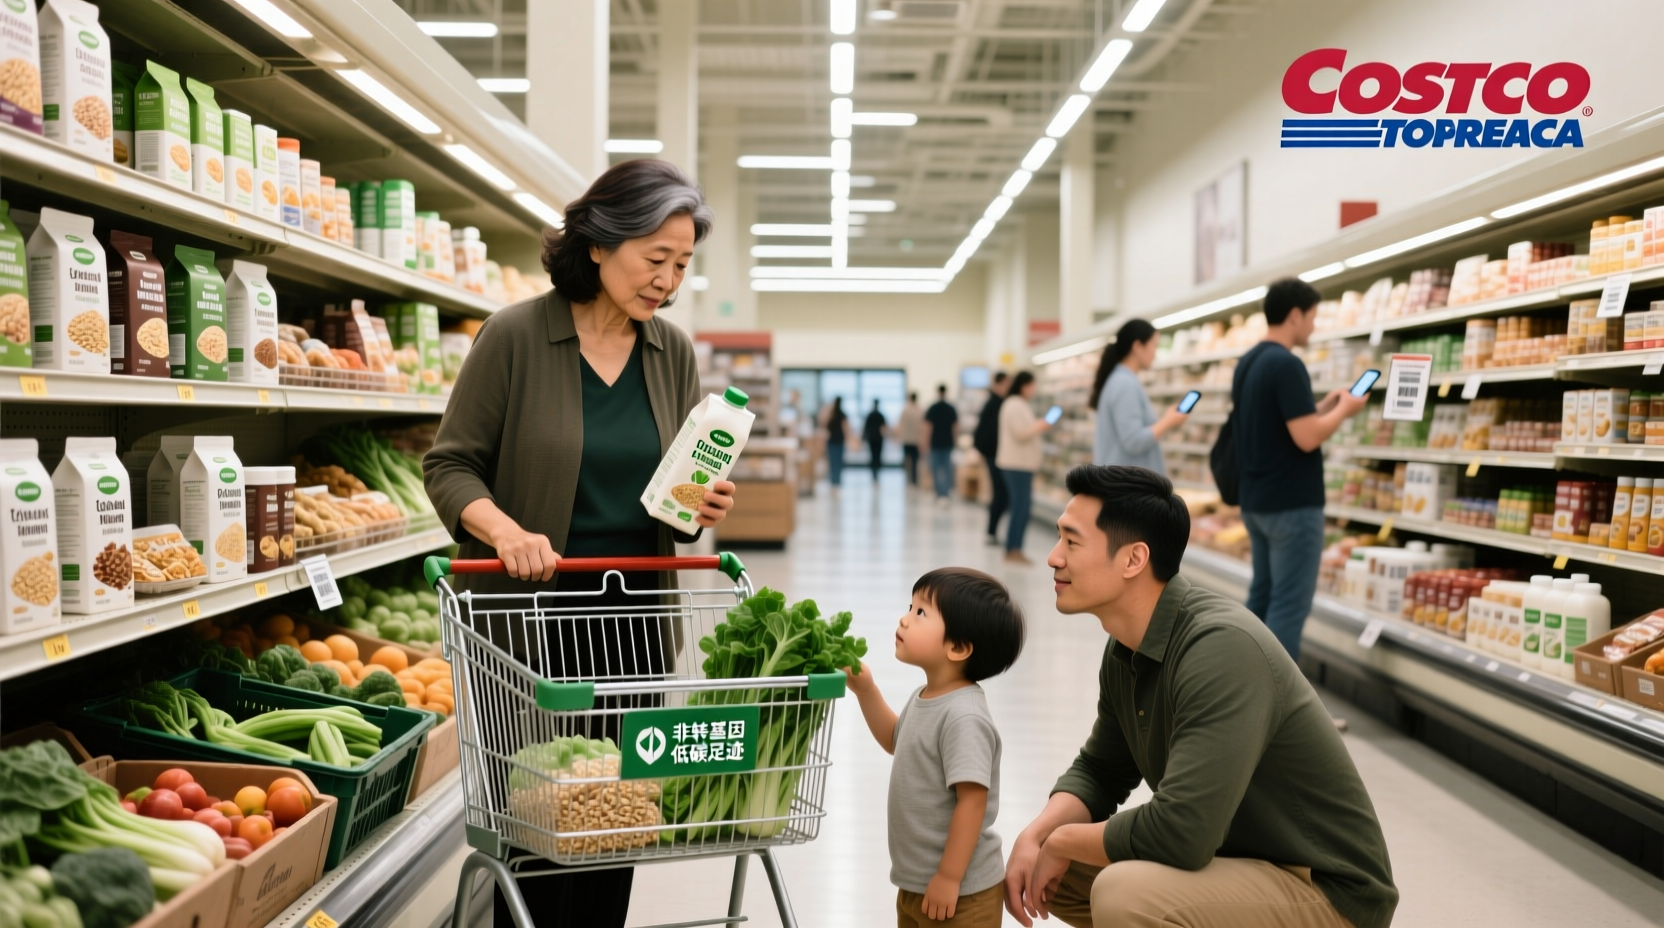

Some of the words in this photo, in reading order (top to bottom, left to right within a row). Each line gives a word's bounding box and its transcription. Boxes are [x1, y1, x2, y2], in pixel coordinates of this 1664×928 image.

[672, 719, 746, 743] 非转基因
[670, 740, 745, 765] 低碳足迹
